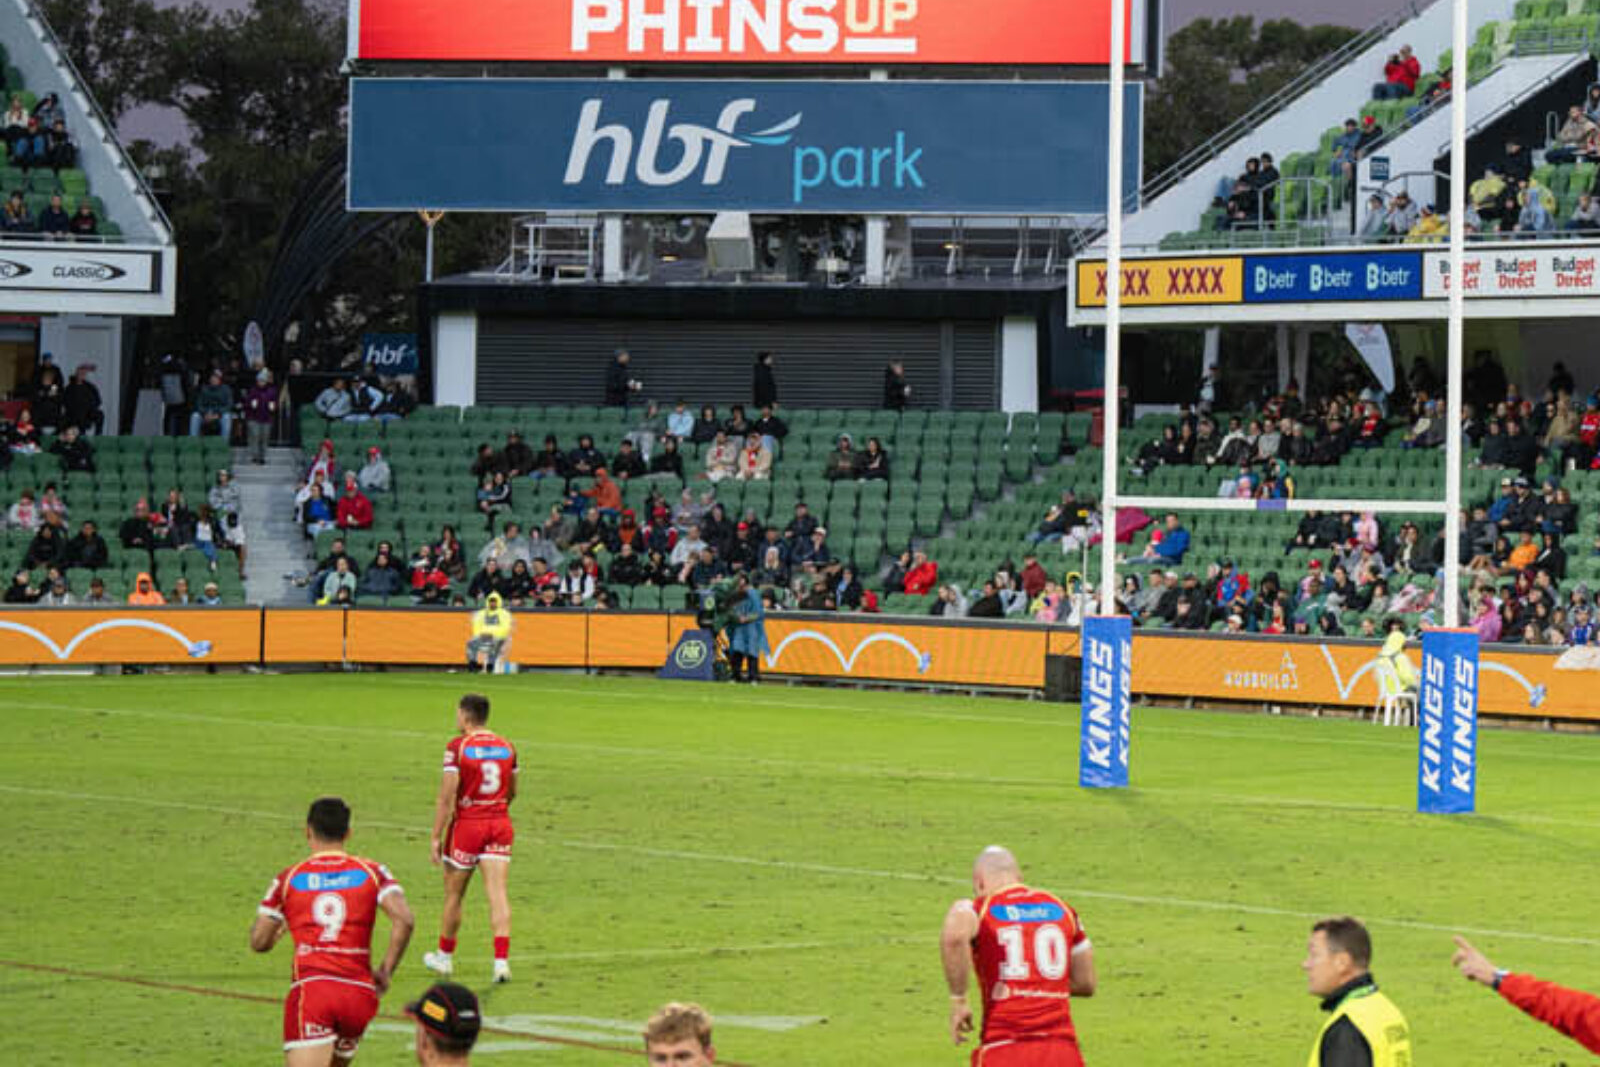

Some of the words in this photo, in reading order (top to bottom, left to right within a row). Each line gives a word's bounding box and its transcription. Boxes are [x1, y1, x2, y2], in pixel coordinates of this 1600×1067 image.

[563, 98, 756, 185] hbf
[794, 131, 924, 202] park
[52, 266, 105, 279] CLASSIC
[1268, 269, 1298, 289] betr
[1324, 266, 1352, 288] betr
[1380, 265, 1411, 286] betr
[1439, 258, 1481, 275] Bget
[1495, 258, 1537, 276] Budget
[1552, 255, 1595, 274] Budget
[1444, 275, 1479, 290] Dect
[1498, 274, 1535, 289] Direct
[1556, 272, 1593, 288] Direct
[1095, 269, 1149, 297] XXX
[1168, 266, 1224, 295] XXXX
[364, 343, 408, 366] hbf
[1088, 637, 1113, 768] KINGS
[1422, 653, 1446, 793] KINGS
[1450, 654, 1475, 794] KINGS
[480, 761, 501, 794] 3
[312, 893, 347, 942] 9
[997, 924, 1068, 981] 10
